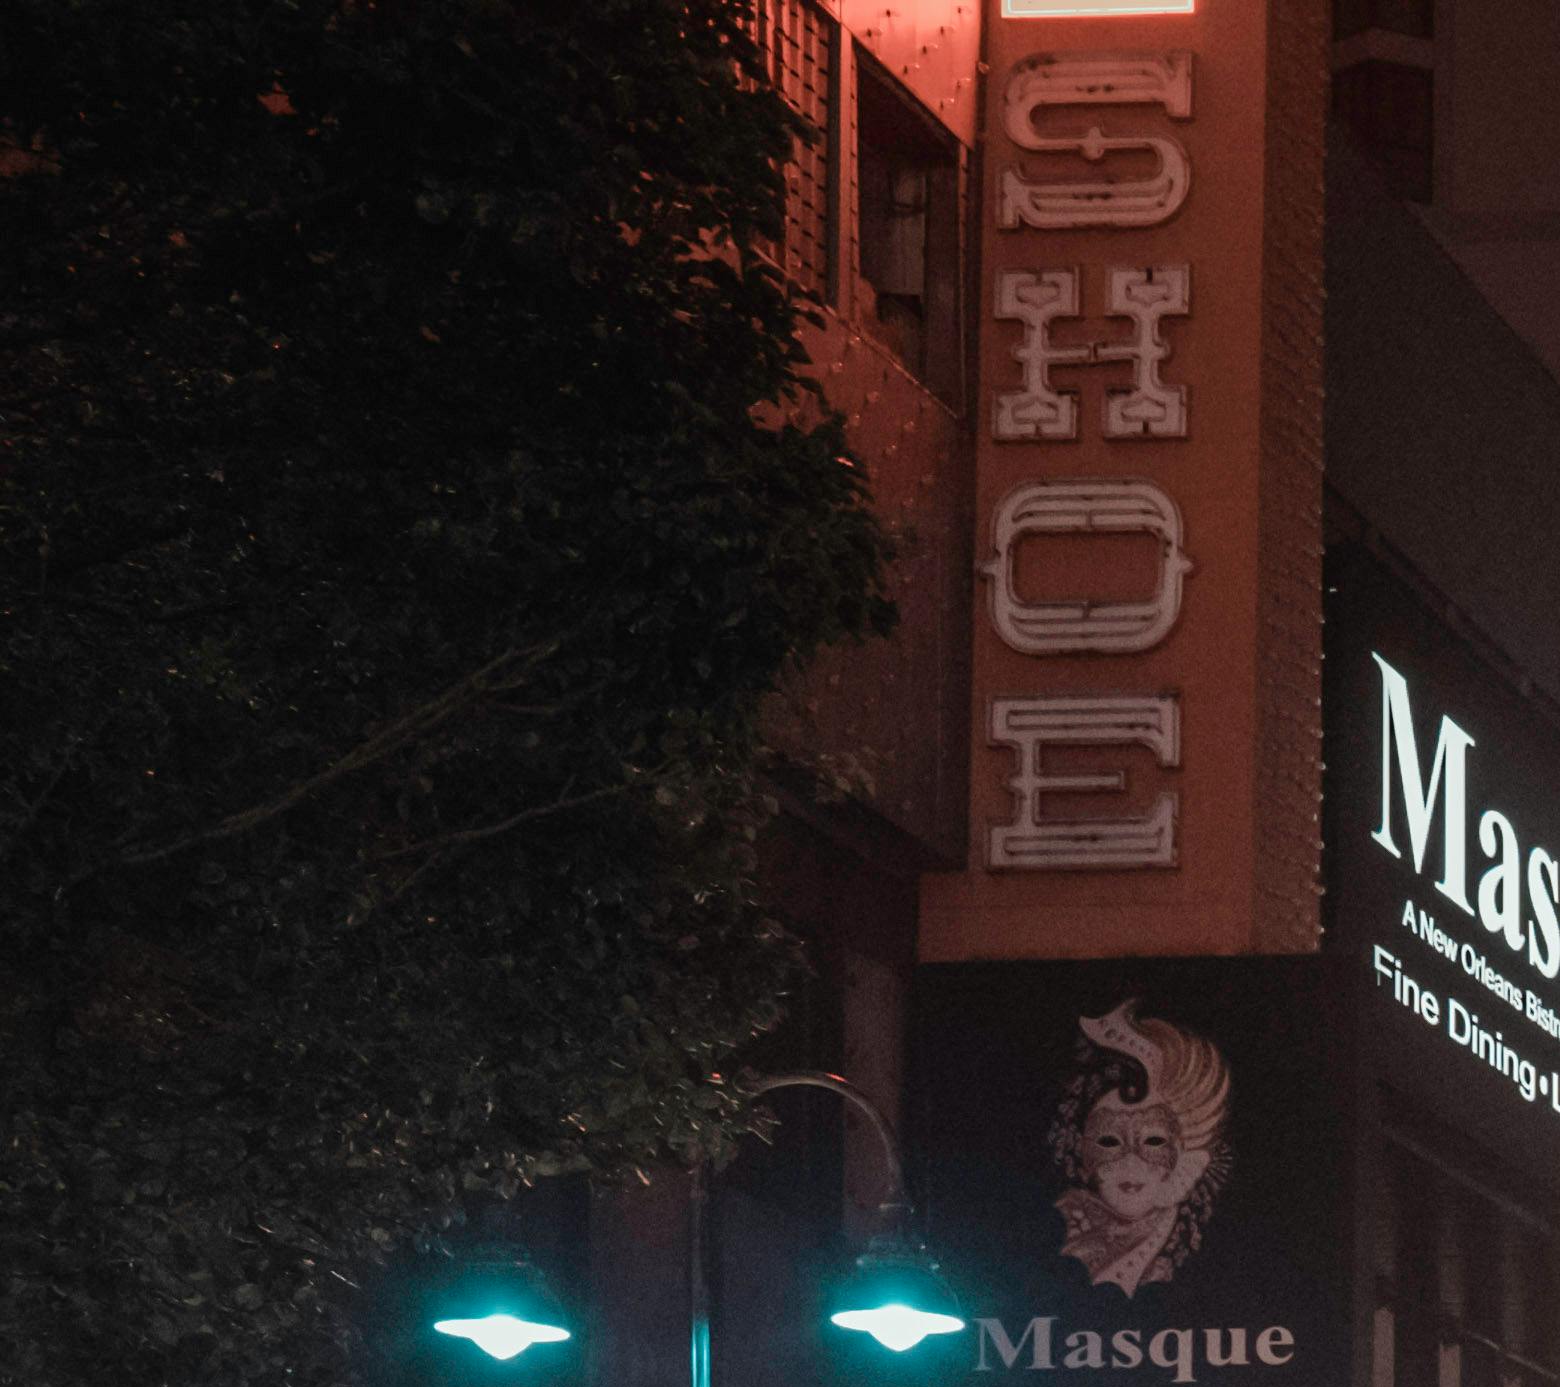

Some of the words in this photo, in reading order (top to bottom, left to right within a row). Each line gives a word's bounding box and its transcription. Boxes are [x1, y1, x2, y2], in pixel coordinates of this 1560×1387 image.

[979, 0, 1196, 872] SHOE
[1373, 944, 1440, 1027] Fine
[1402, 899, 1418, 928] A
[1420, 909, 1458, 961] New
[1461, 942, 1524, 1013] Orleans
[973, 1314, 1296, 1383] Masque
